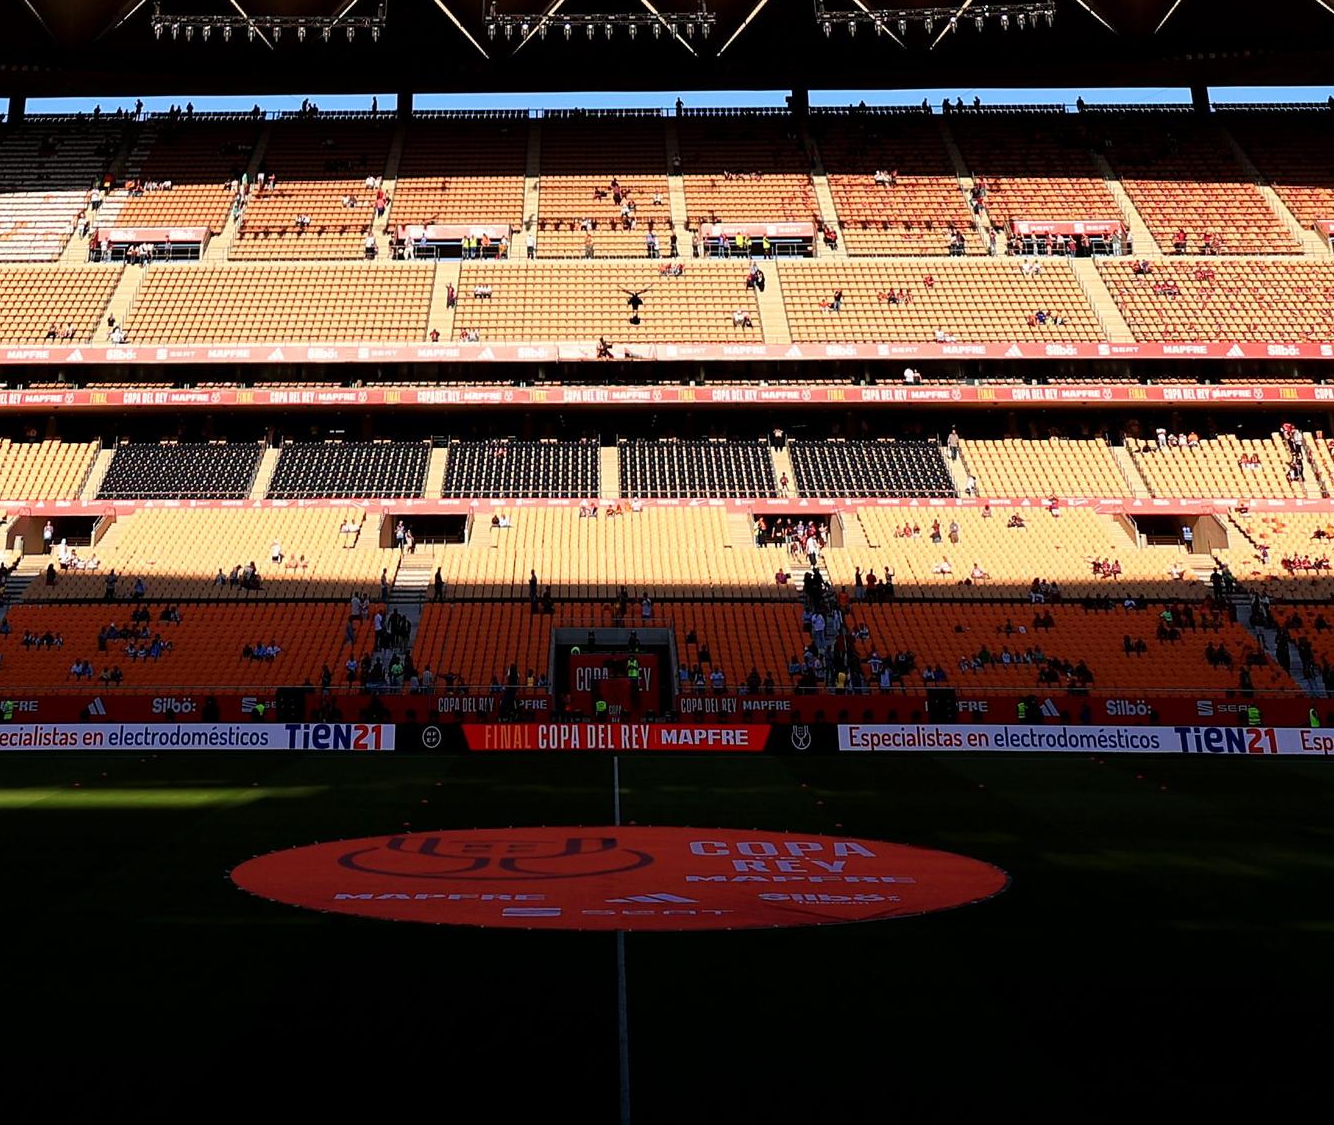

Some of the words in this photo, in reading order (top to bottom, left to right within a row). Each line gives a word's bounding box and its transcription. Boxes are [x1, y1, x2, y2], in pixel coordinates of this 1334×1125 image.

[1163, 345, 1207, 355] MAPFRE
[439, 697, 459, 713] COPA
[463, 697, 477, 713] DEL
[681, 698, 702, 713] COPA
[705, 698, 719, 713] DEL
[721, 698, 736, 713] REY
[743, 699, 791, 711] MAPFRE
[1106, 700, 1151, 715] Silbö:
[83, 731, 103, 746] en
[109, 726, 269, 746] electrodomésticos
[485, 725, 531, 749] FINAL
[539, 724, 579, 749] COPA
[587, 724, 615, 749] DEL
[621, 724, 649, 749] REY
[661, 729, 749, 745] MAPFRE
[849, 727, 963, 751] Especialistas
[967, 733, 989, 747] en
[994, 727, 1159, 749] electrodomésticos
[689, 841, 876, 857] COPA
[732, 859, 846, 873] REY
[685, 875, 916, 883] MAPFRE
